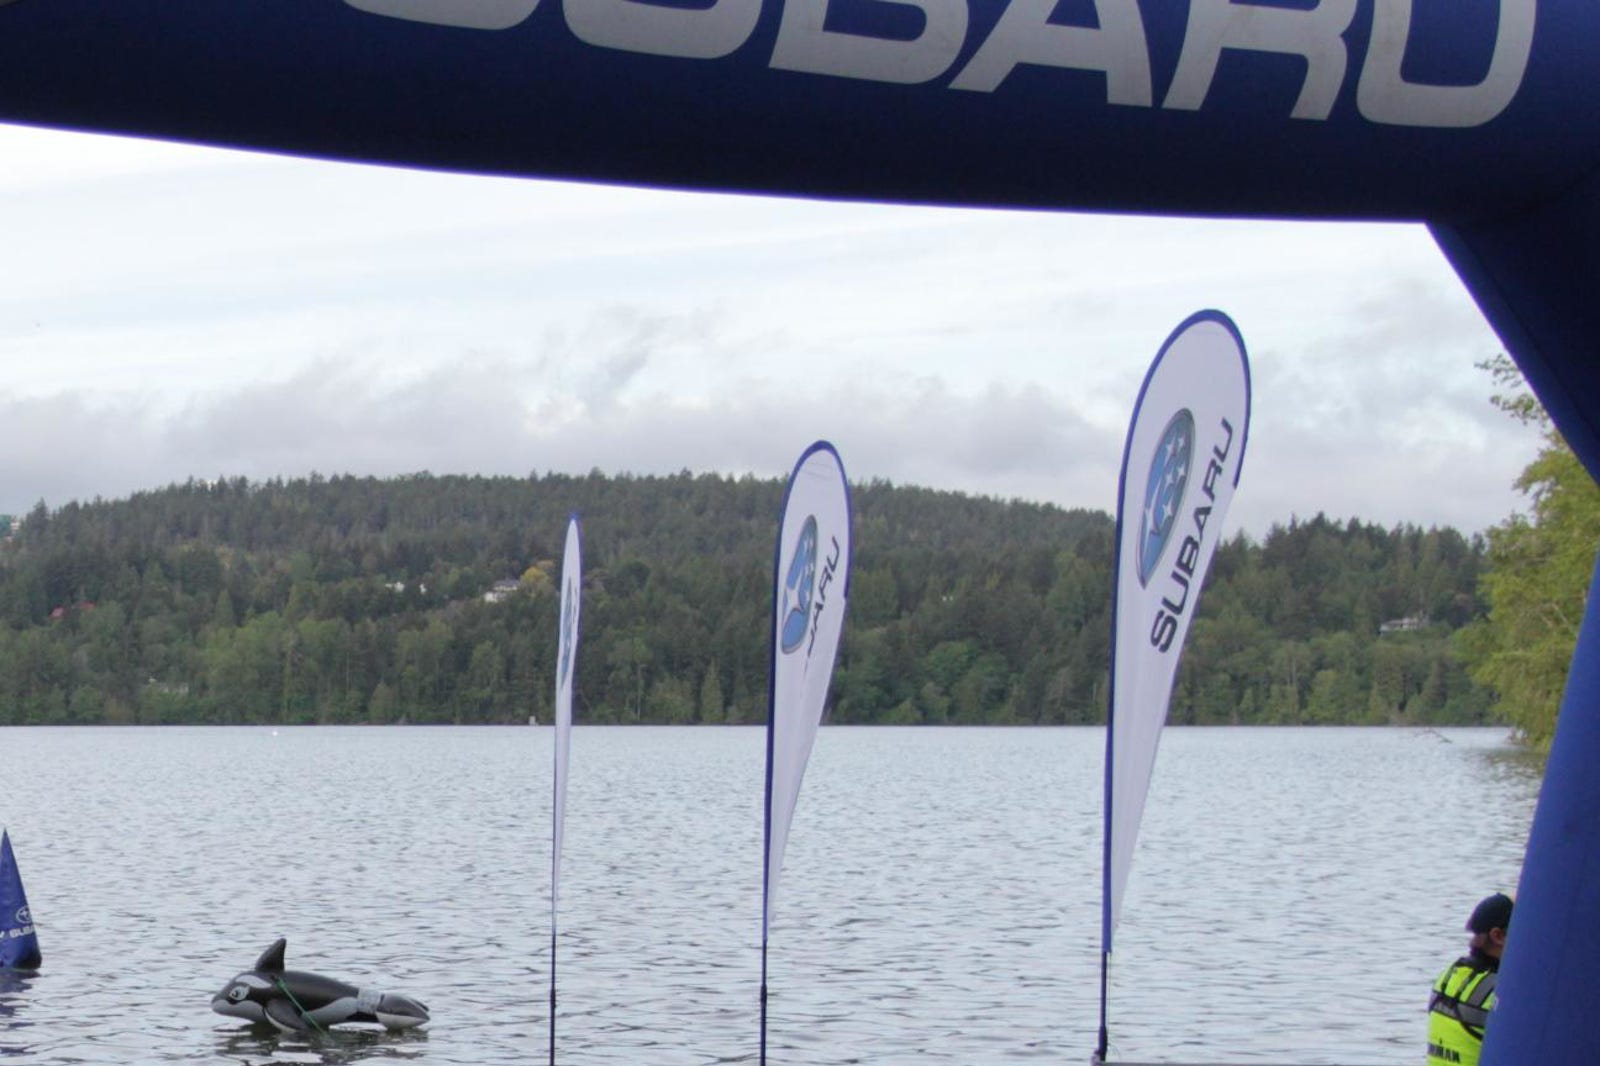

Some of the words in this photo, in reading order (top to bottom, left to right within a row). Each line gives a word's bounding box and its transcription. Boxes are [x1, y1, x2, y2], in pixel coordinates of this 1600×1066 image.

[341, 0, 1538, 128] ARU
[805, 535, 840, 672] ARU
[1150, 418, 1234, 654] SUBARU
